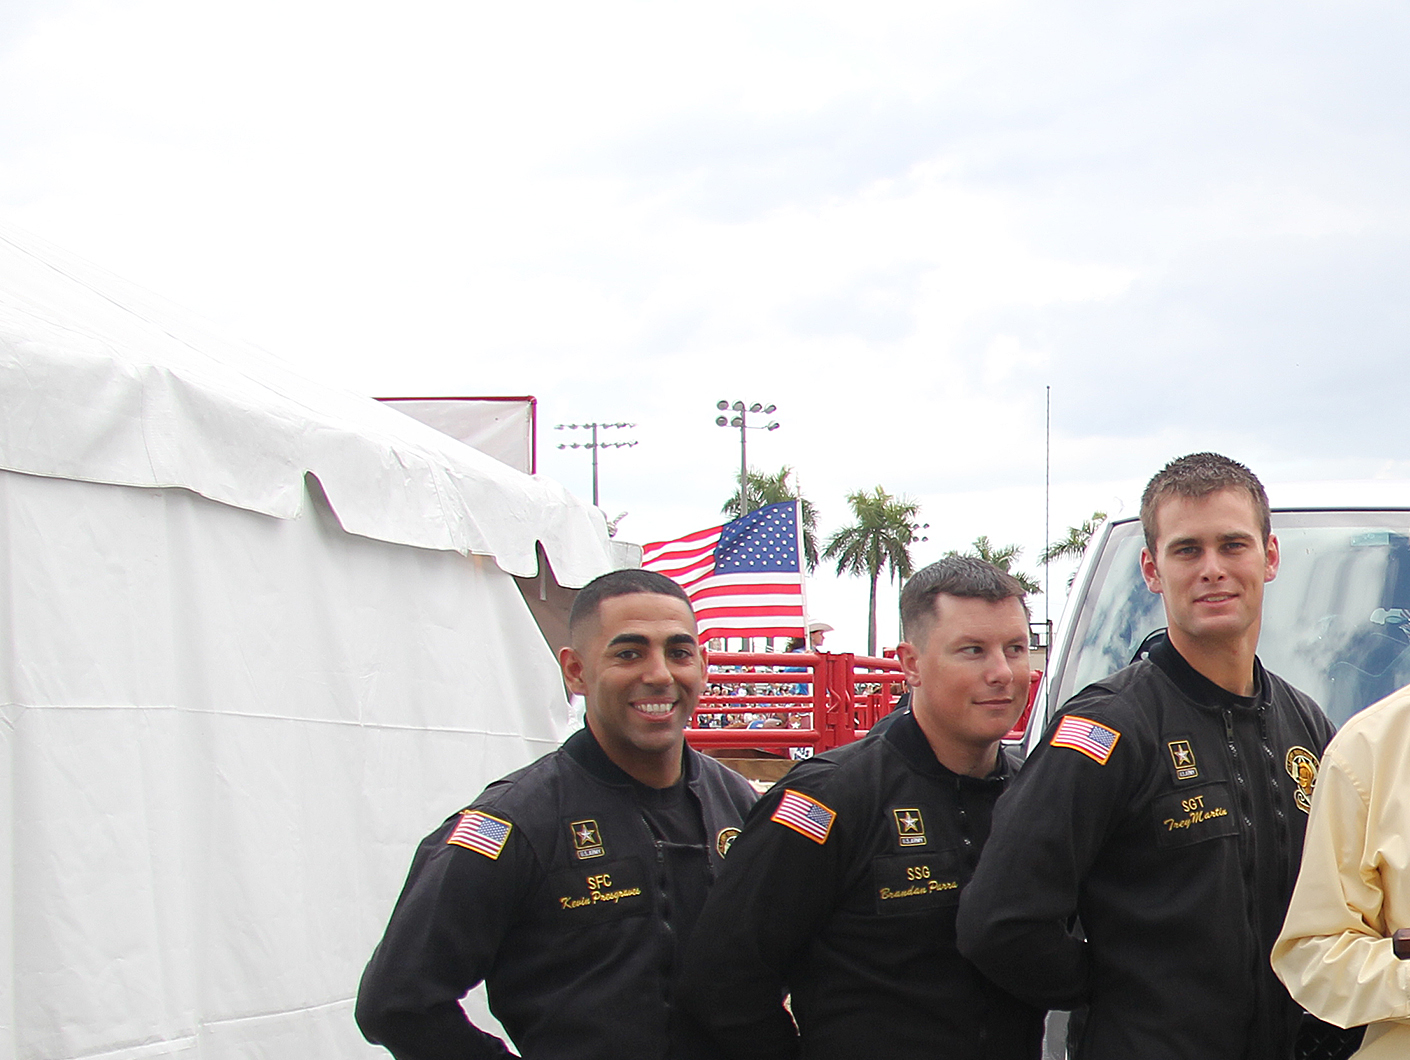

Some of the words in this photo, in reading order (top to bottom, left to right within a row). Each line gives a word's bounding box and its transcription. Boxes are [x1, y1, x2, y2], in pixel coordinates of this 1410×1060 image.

[1181, 795, 1204, 812] SGT
[1163, 818, 1191, 831] Trey
[1189, 807, 1228, 823] Martin
[587, 873, 612, 890] SFC
[906, 865, 931, 881] SSG
[559, 896, 591, 909] Kevin
